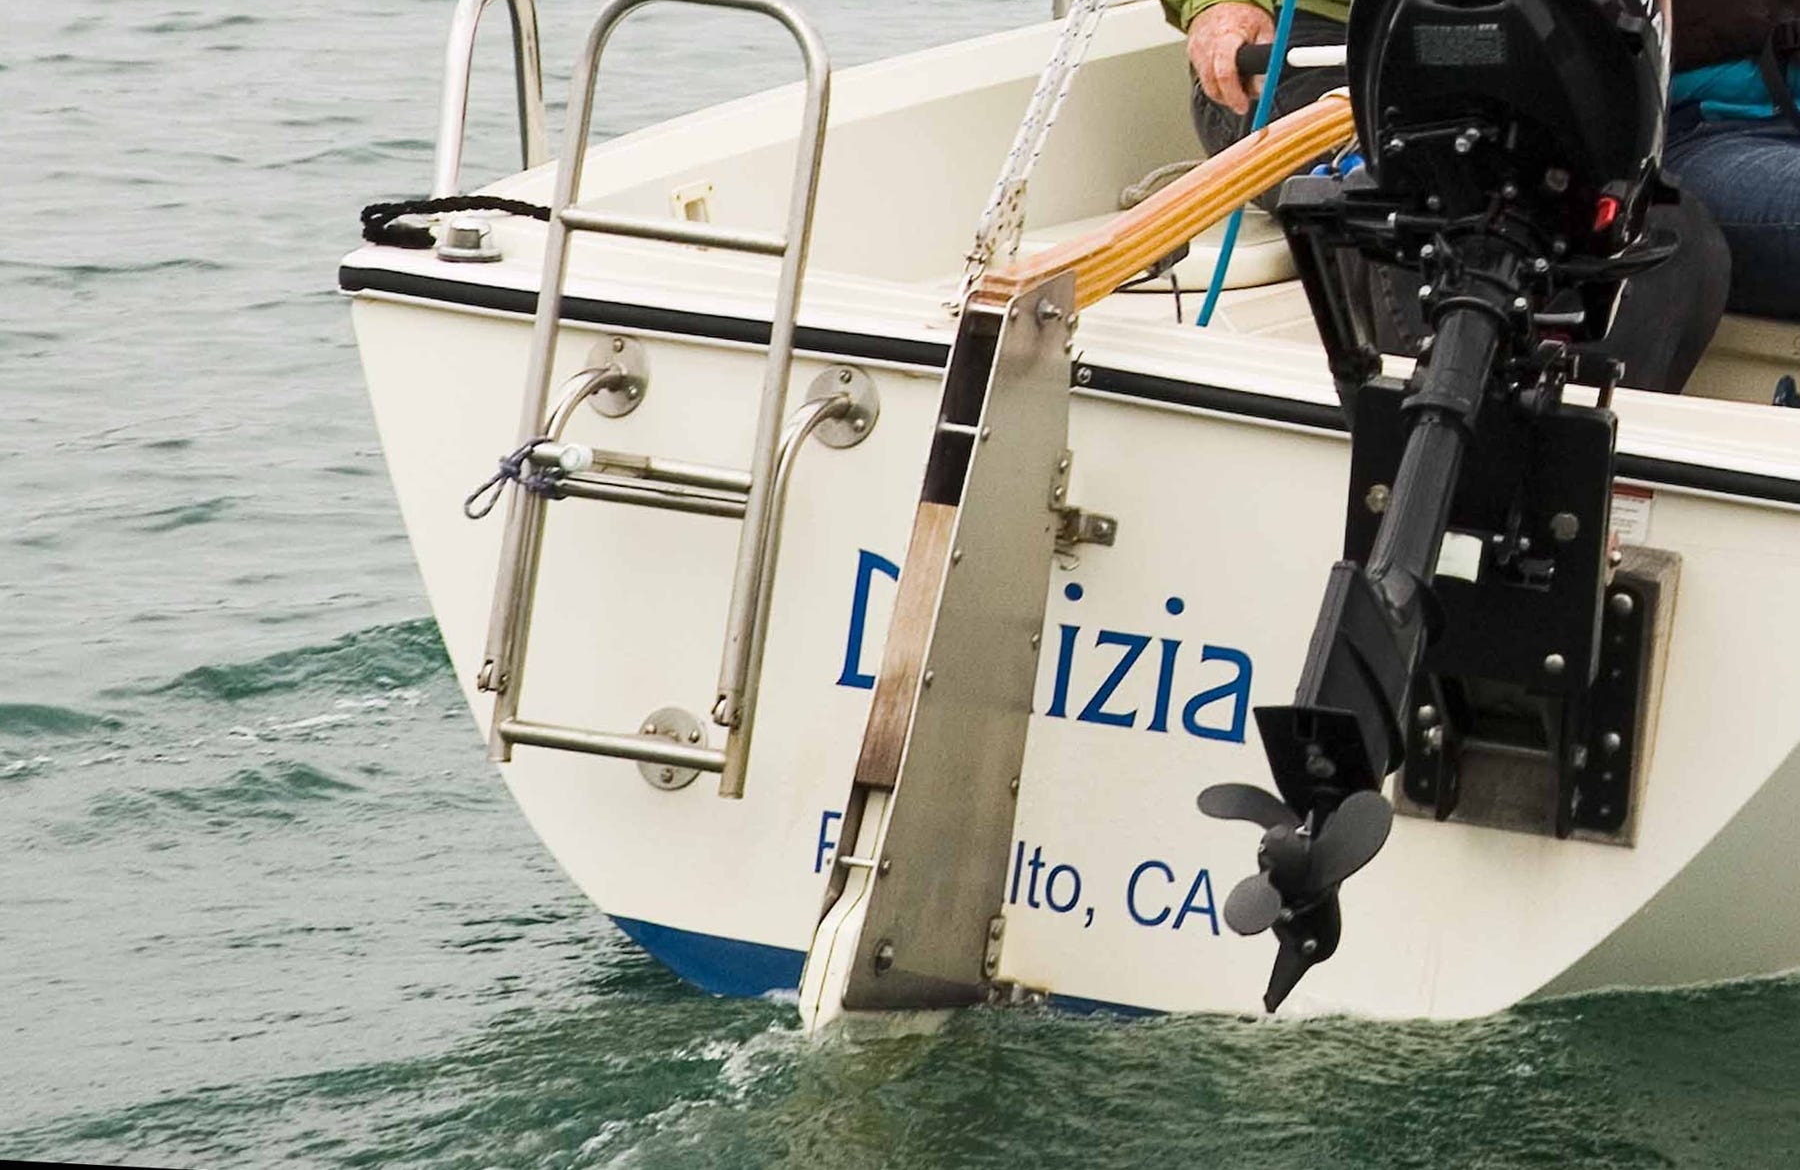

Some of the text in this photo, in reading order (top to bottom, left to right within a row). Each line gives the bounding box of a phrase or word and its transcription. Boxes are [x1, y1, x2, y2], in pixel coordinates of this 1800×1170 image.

[835, 548, 1254, 744] Dizia
[1002, 840, 1221, 937] lto, CA
